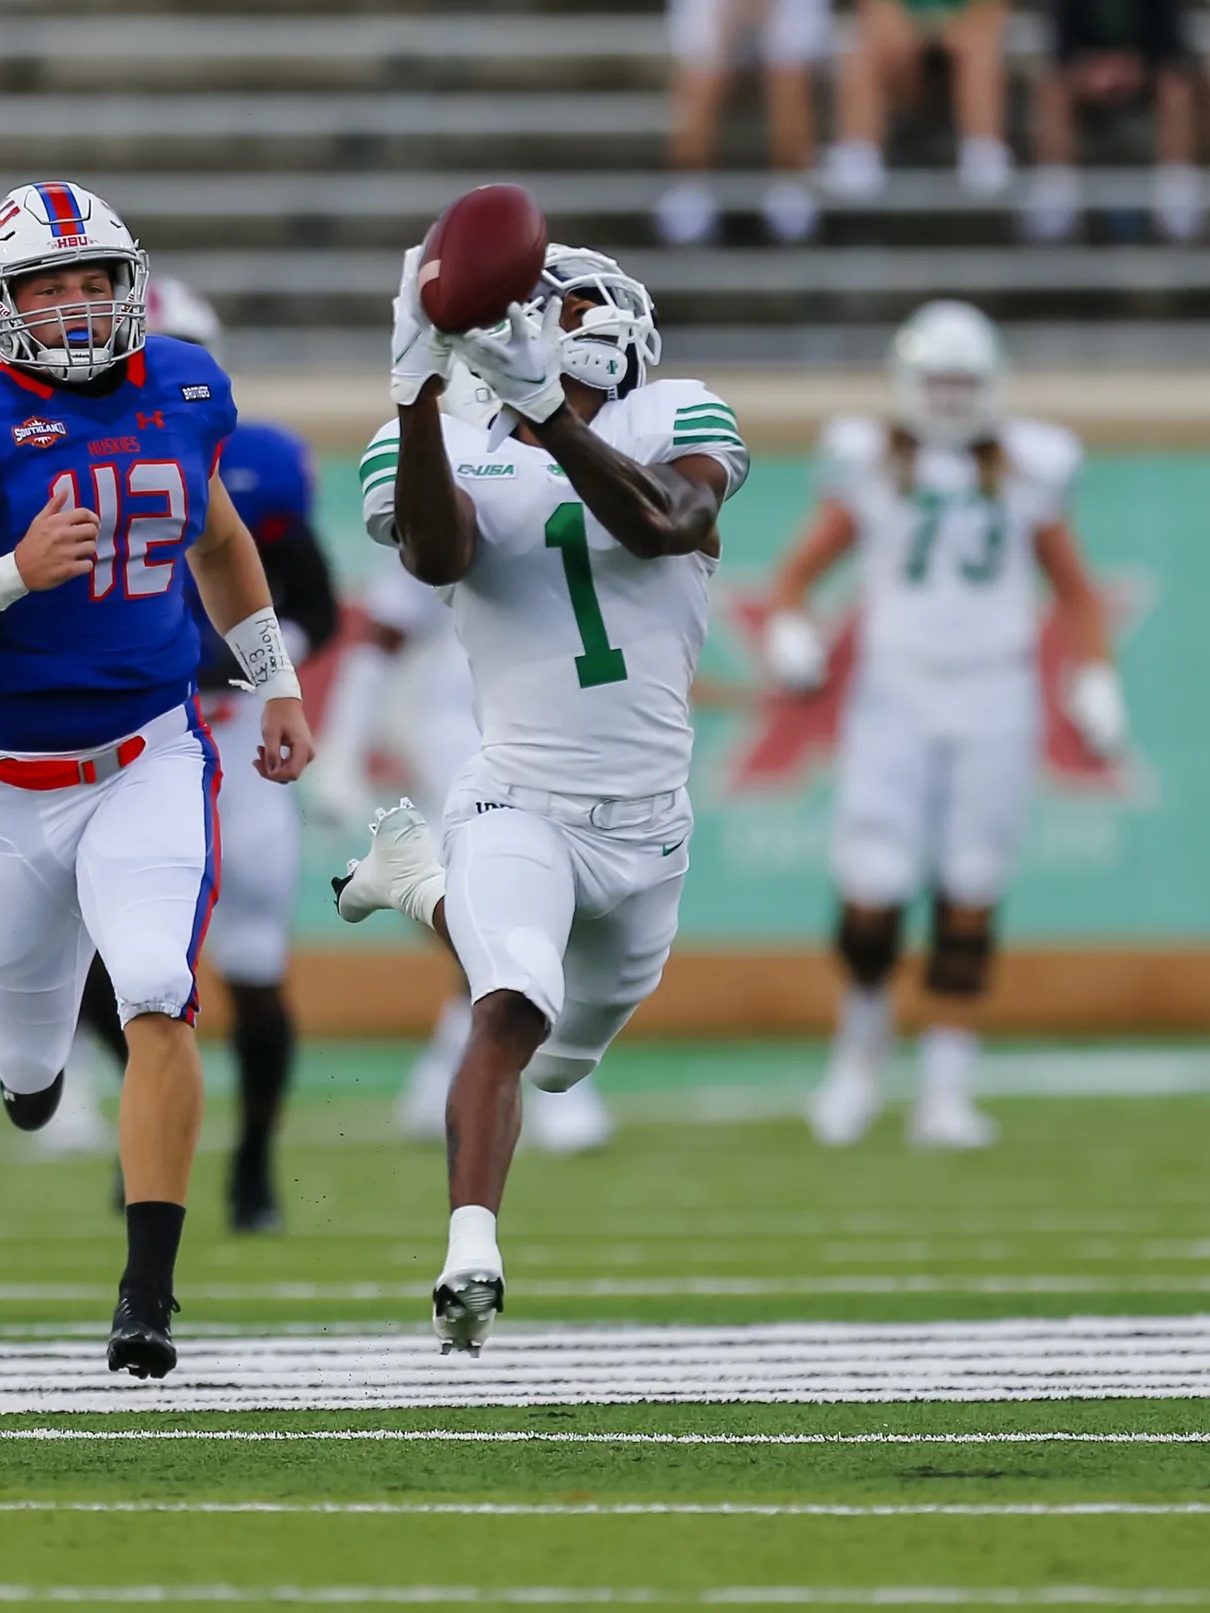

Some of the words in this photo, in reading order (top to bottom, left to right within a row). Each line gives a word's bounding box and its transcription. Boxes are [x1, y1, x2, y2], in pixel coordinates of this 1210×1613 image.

[56, 236, 88, 249] HBU
[13, 420, 66, 442] SOUTHLAND
[87, 436, 140, 457] HUSKIES
[545, 502, 628, 688] 1
